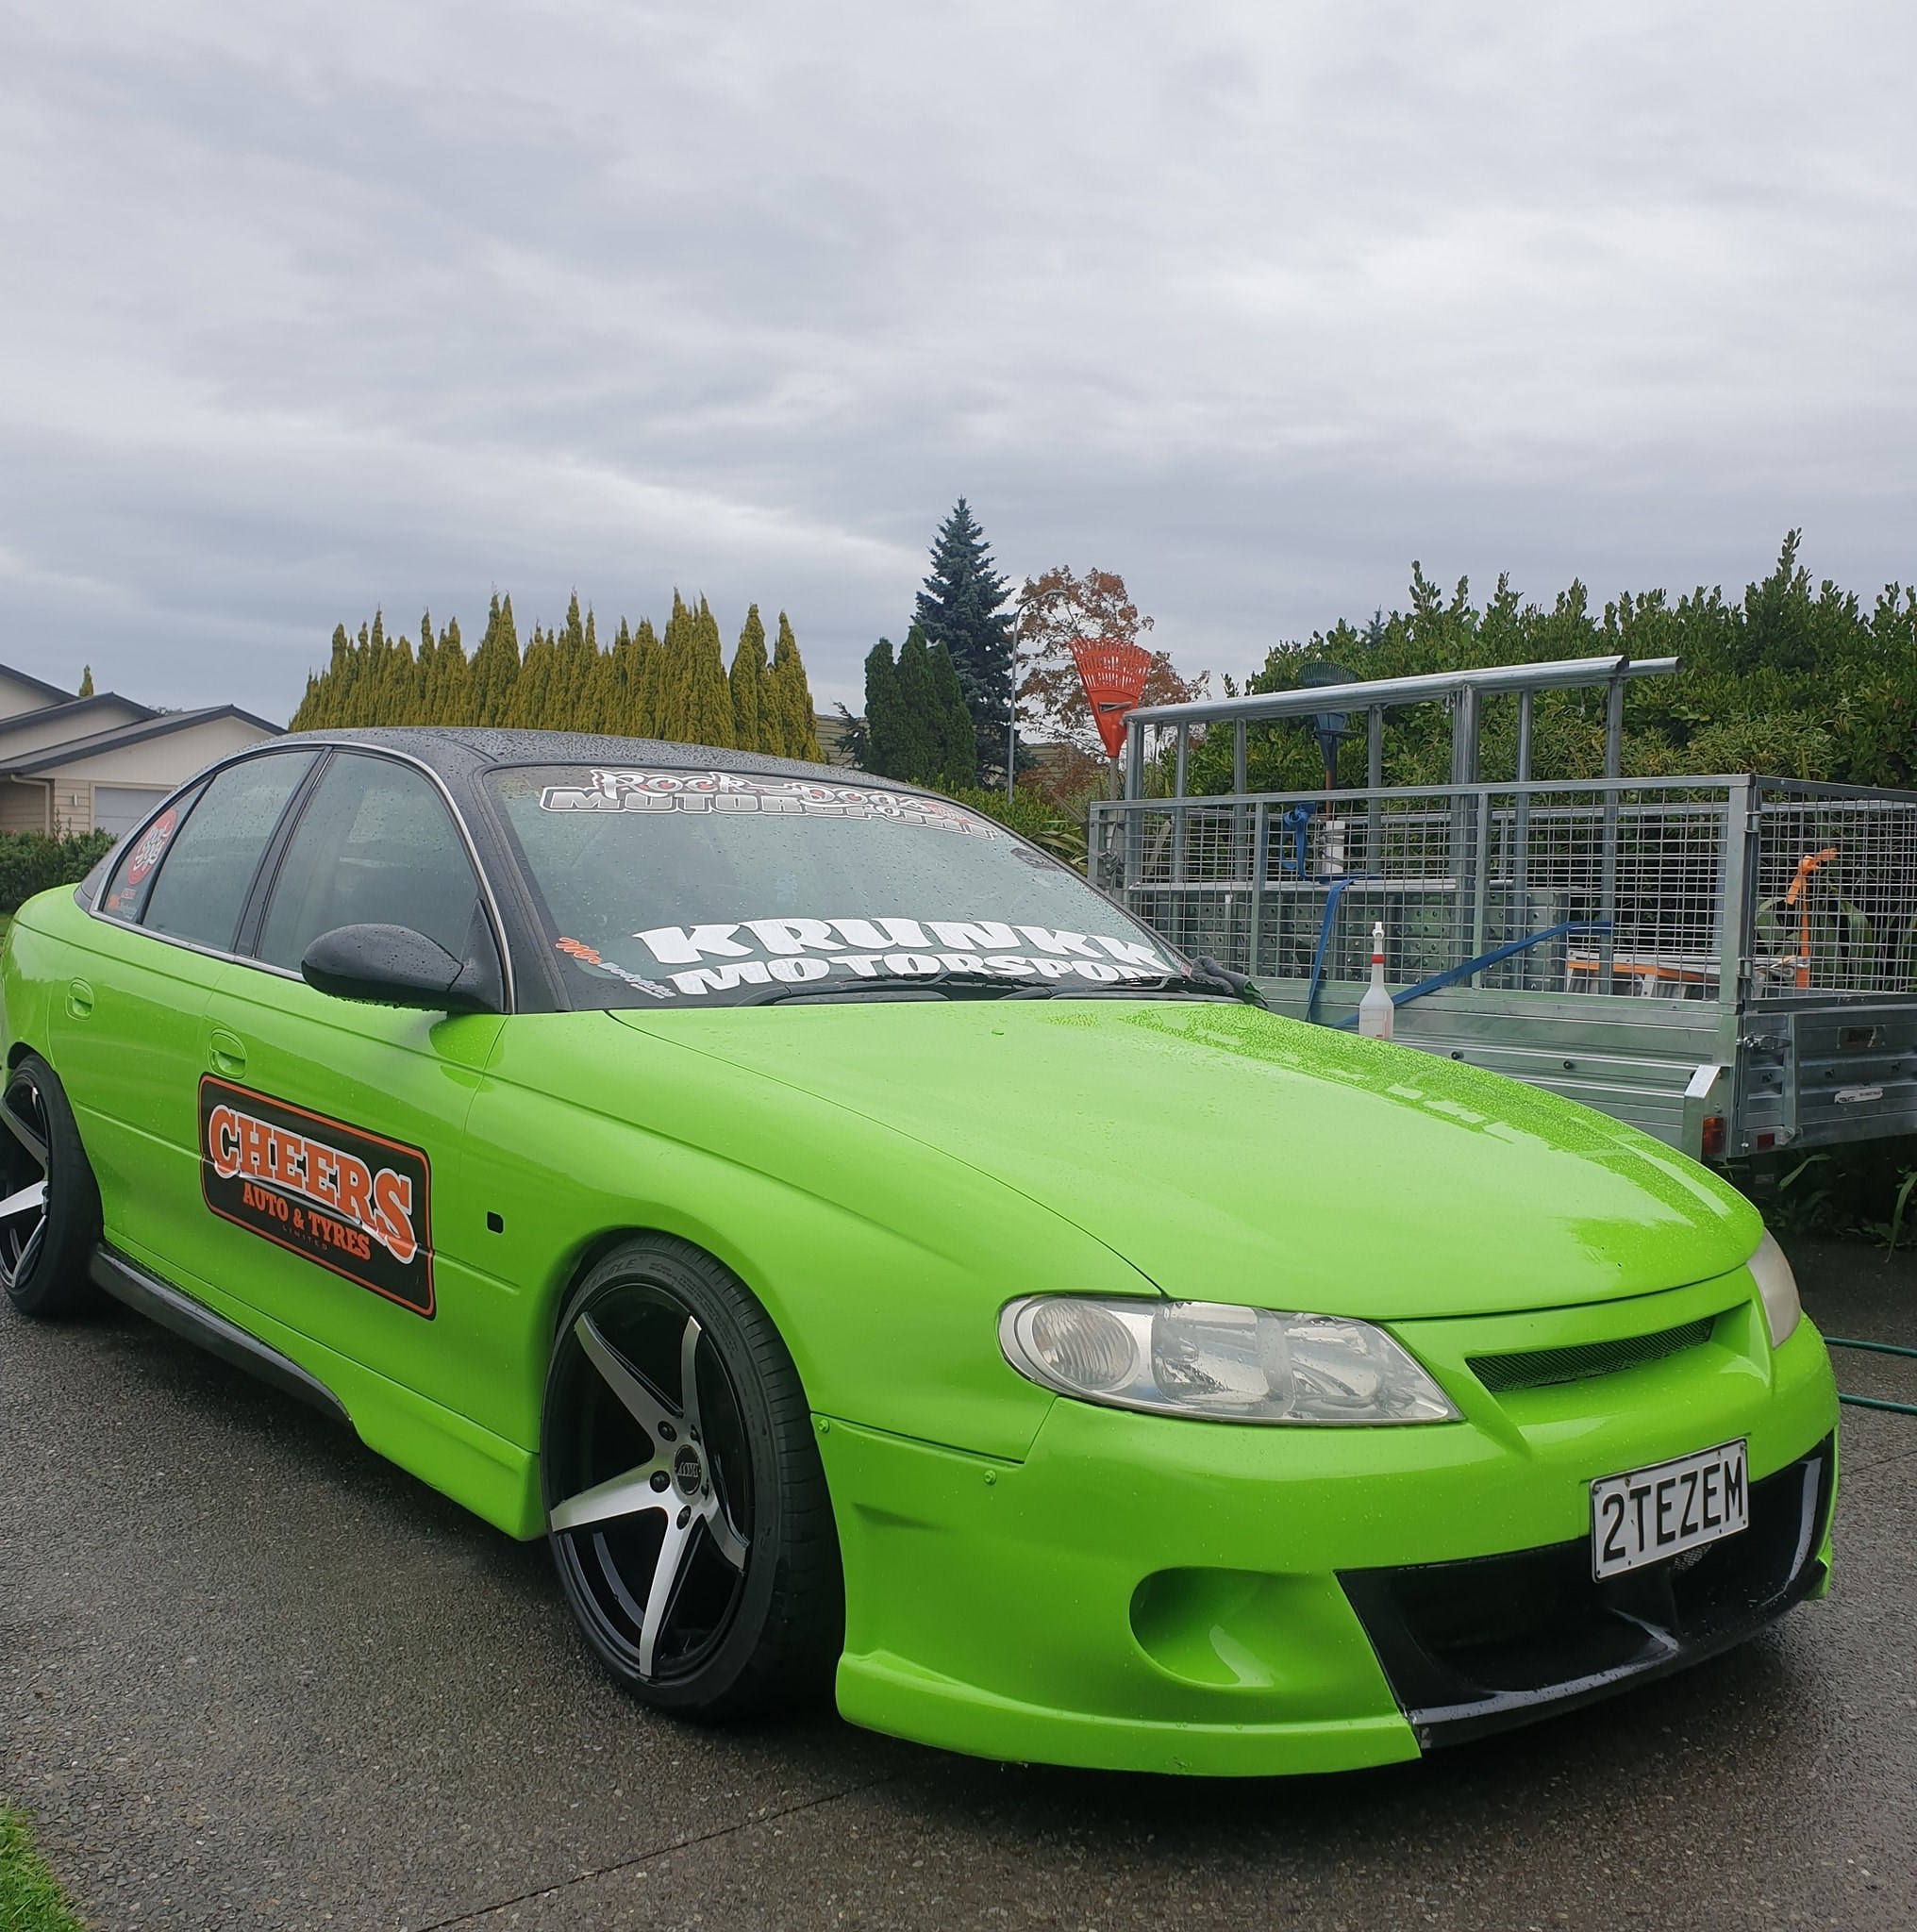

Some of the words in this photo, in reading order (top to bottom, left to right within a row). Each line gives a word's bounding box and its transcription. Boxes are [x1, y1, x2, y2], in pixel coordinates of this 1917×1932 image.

[592, 769, 753, 801] Rock
[632, 917, 1175, 972] KRUNKK
[666, 953, 1169, 995] MOTORSPOR
[208, 1104, 418, 1265] CHEERS
[242, 1181, 289, 1224] AUTO
[292, 1208, 305, 1231] &
[308, 1210, 371, 1261] TYRES
[282, 1224, 328, 1251] LIMITED
[1601, 1456, 1743, 1563] 2TEZEM
